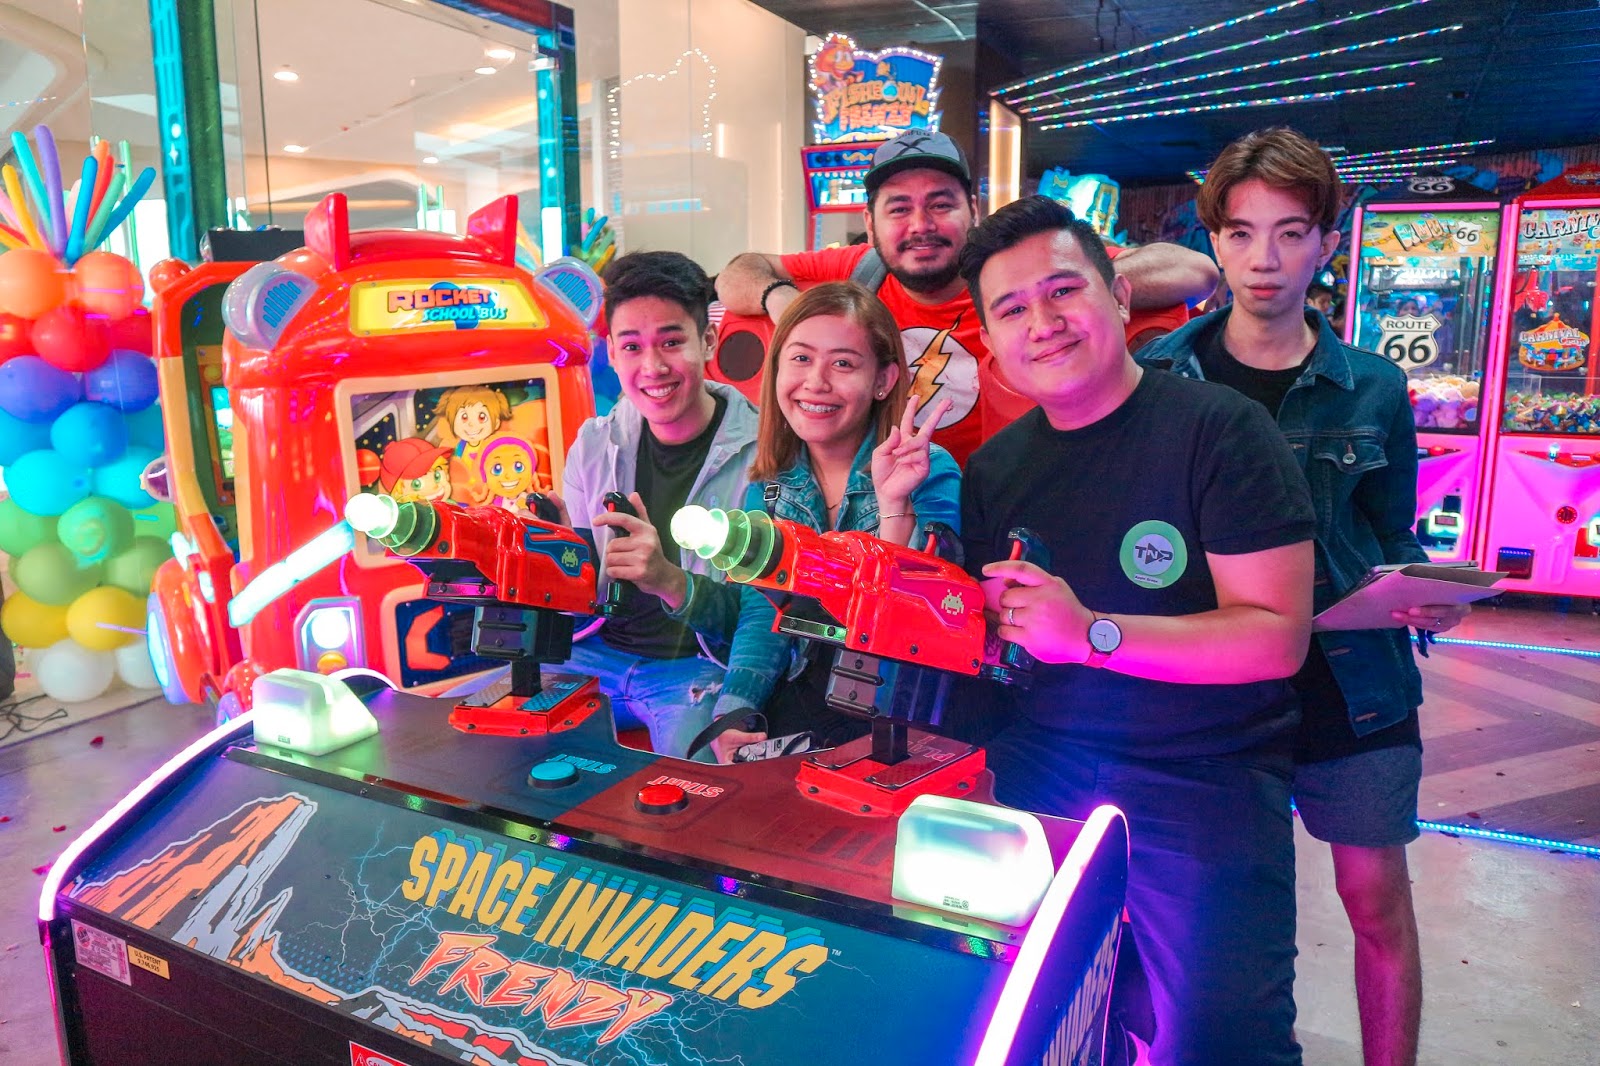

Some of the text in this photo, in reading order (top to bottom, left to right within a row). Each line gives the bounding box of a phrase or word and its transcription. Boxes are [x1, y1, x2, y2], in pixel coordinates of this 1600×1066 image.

[1413, 182, 1449, 191] 66
[1456, 227, 1479, 242] 66
[387, 288, 492, 313] ROCKET
[422, 307, 507, 322] SCHOOL BUS
[1386, 320, 1432, 330] ROUTE
[1520, 328, 1581, 342] CARNIVAL
[1383, 334, 1430, 363] 66
[401, 830, 558, 936] SPACE
[532, 870, 829, 1010] INVADERS
[144, 954, 161, 966] PATENT
[409, 932, 673, 1044] FRENZY
